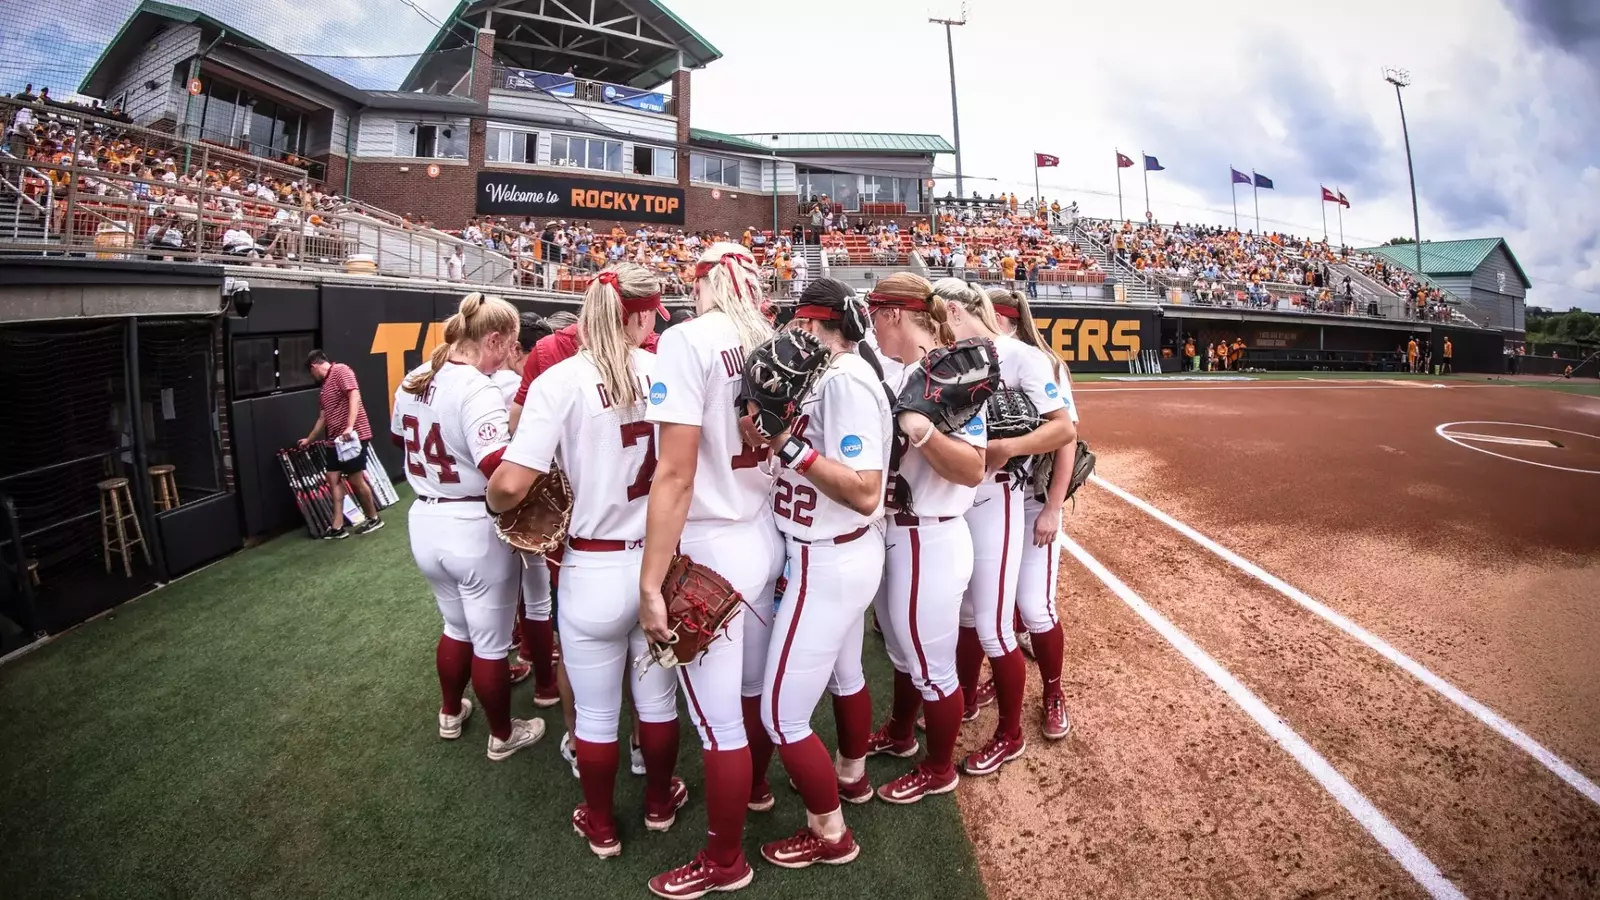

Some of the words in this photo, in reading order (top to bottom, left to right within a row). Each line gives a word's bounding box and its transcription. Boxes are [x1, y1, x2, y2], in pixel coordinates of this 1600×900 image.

[485, 182, 544, 203] Welcome
[546, 190, 560, 204] to
[571, 188, 640, 212] ROCKY
[642, 194, 679, 214] TOP
[402, 414, 461, 484] 24
[619, 421, 658, 502] 7
[773, 478, 818, 528] 22
